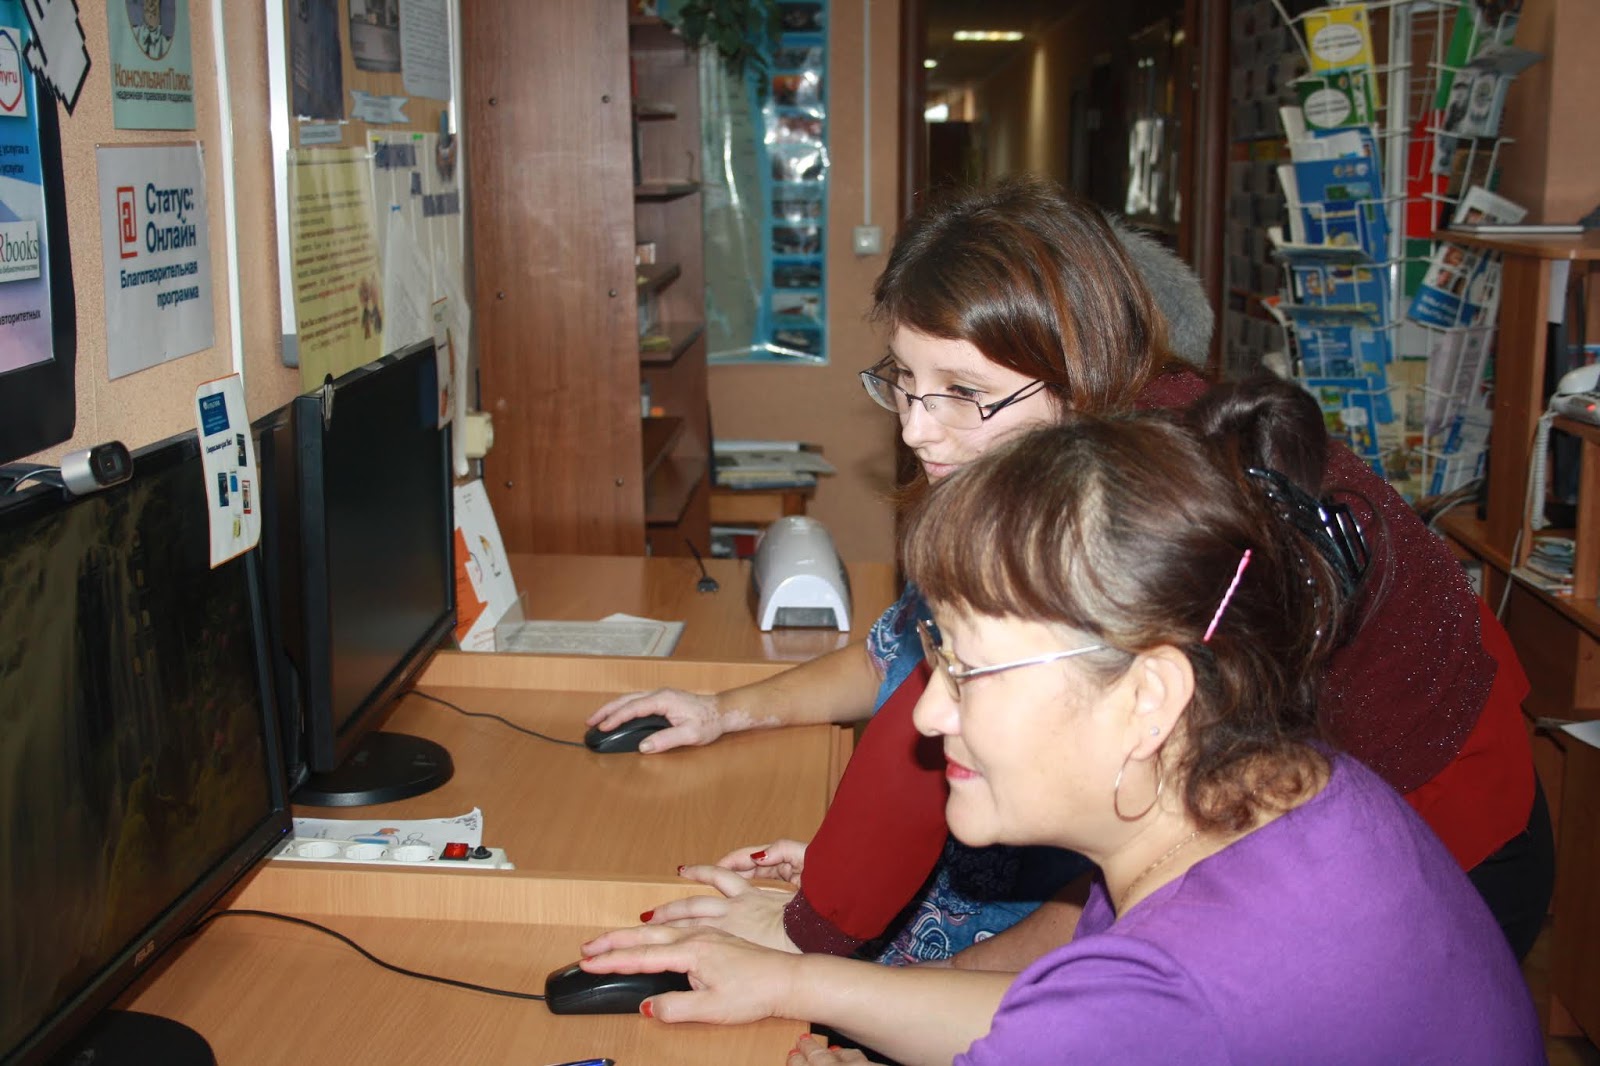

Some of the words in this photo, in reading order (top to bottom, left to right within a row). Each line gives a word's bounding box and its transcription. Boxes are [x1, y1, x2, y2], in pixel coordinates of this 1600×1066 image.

[146, 182, 194, 220] Статус:
[146, 217, 197, 253] Онлайн
[120, 260, 198, 289] Благотворительная
[156, 286, 199, 311] программа
